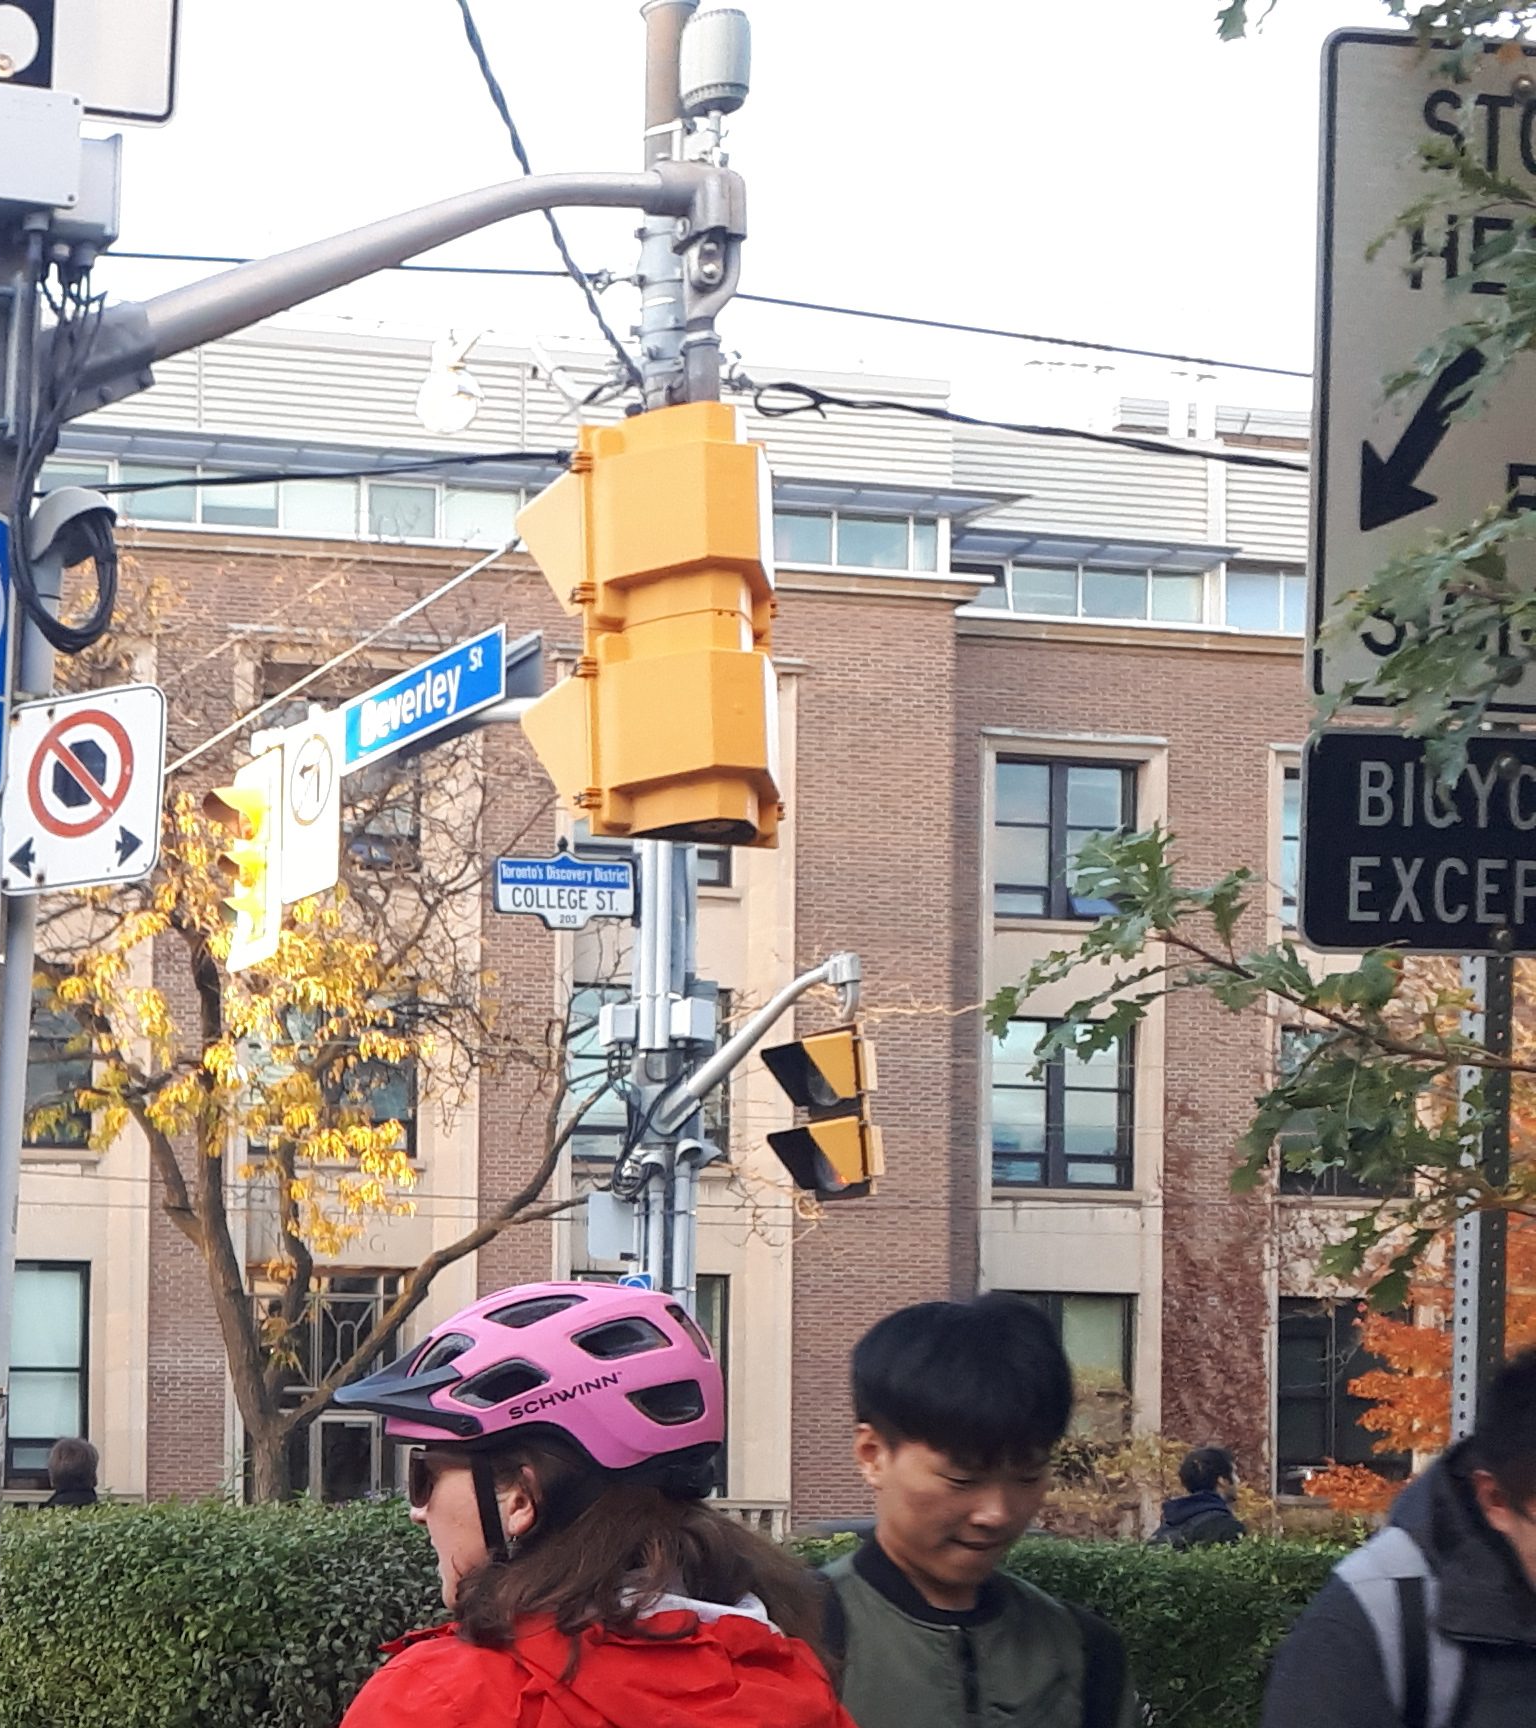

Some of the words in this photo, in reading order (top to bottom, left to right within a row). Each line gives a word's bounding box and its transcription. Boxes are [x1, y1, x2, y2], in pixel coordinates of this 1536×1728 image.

[360, 664, 461, 748] Beverley
[469, 645, 483, 672] St
[501, 863, 544, 880] Toronto's
[546, 866, 593, 884] Discovery
[594, 867, 630, 883] District
[512, 887, 588, 910] COLLEGE
[596, 891, 619, 912] ST.
[559, 914, 577, 925] 203
[509, 1372, 619, 1419] SCHWINN
